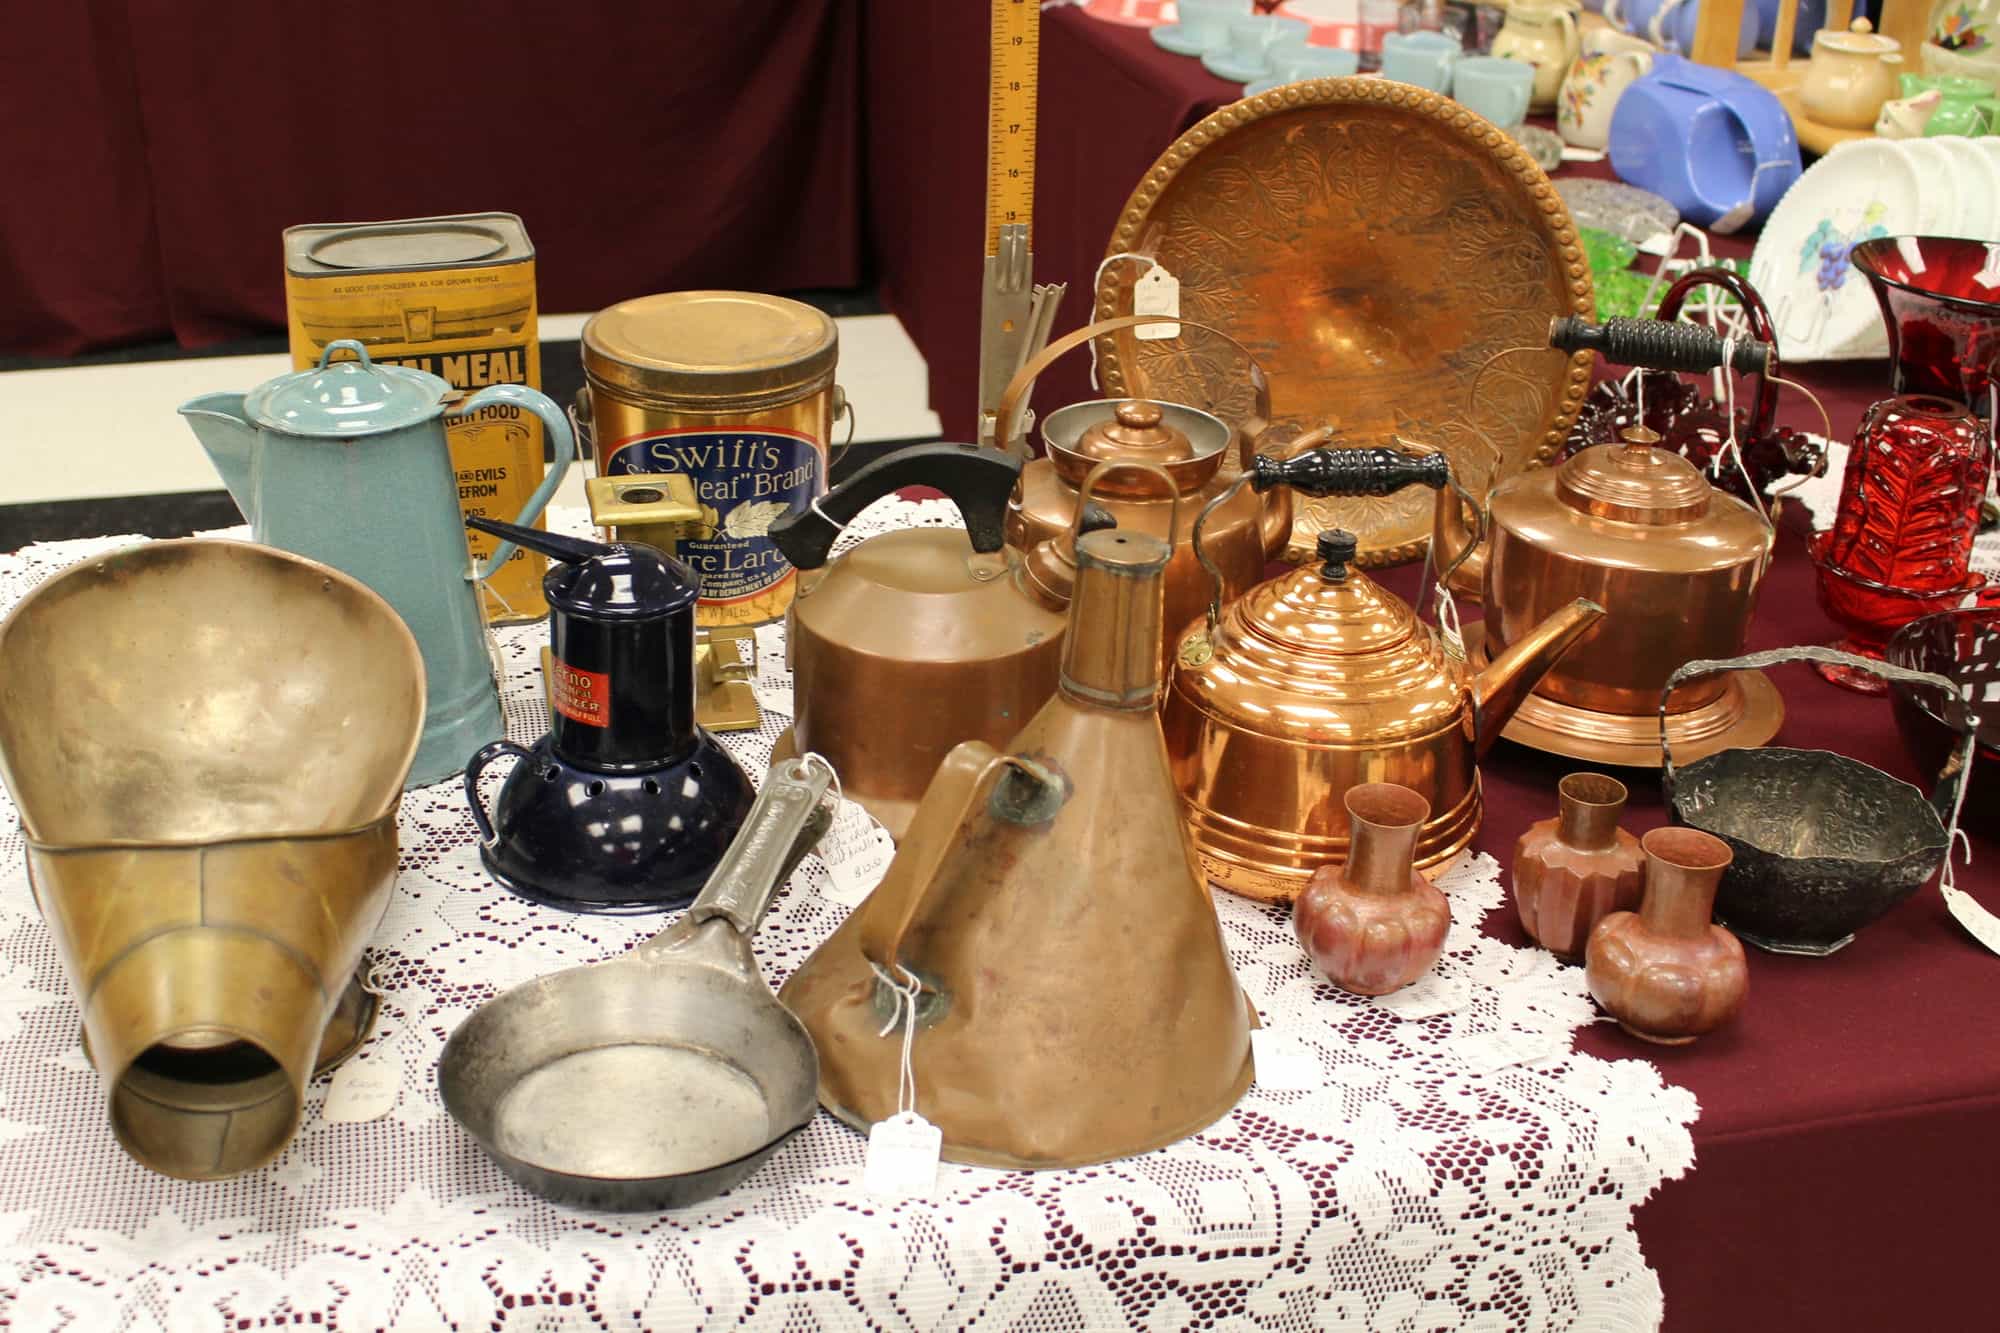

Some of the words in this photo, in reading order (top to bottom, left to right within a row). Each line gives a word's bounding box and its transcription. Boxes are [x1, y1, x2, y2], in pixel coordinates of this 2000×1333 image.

[1011, 36, 1023, 46] 19
[1009, 81, 1020, 91] 18
[1009, 125, 1020, 134] 17
[1008, 168, 1019, 178] 16
[1006, 211, 1016, 220] 15
[443, 351, 523, 387] MEAL
[480, 404, 520, 420] FOOD
[651, 438, 781, 474] Swift's
[475, 467, 507, 482] EVILS
[755, 456, 814, 497] Brand
[458, 484, 498, 499] EFROM
[688, 541, 751, 551] Guaranteed
[720, 581, 763, 597] DEPARTMENT
